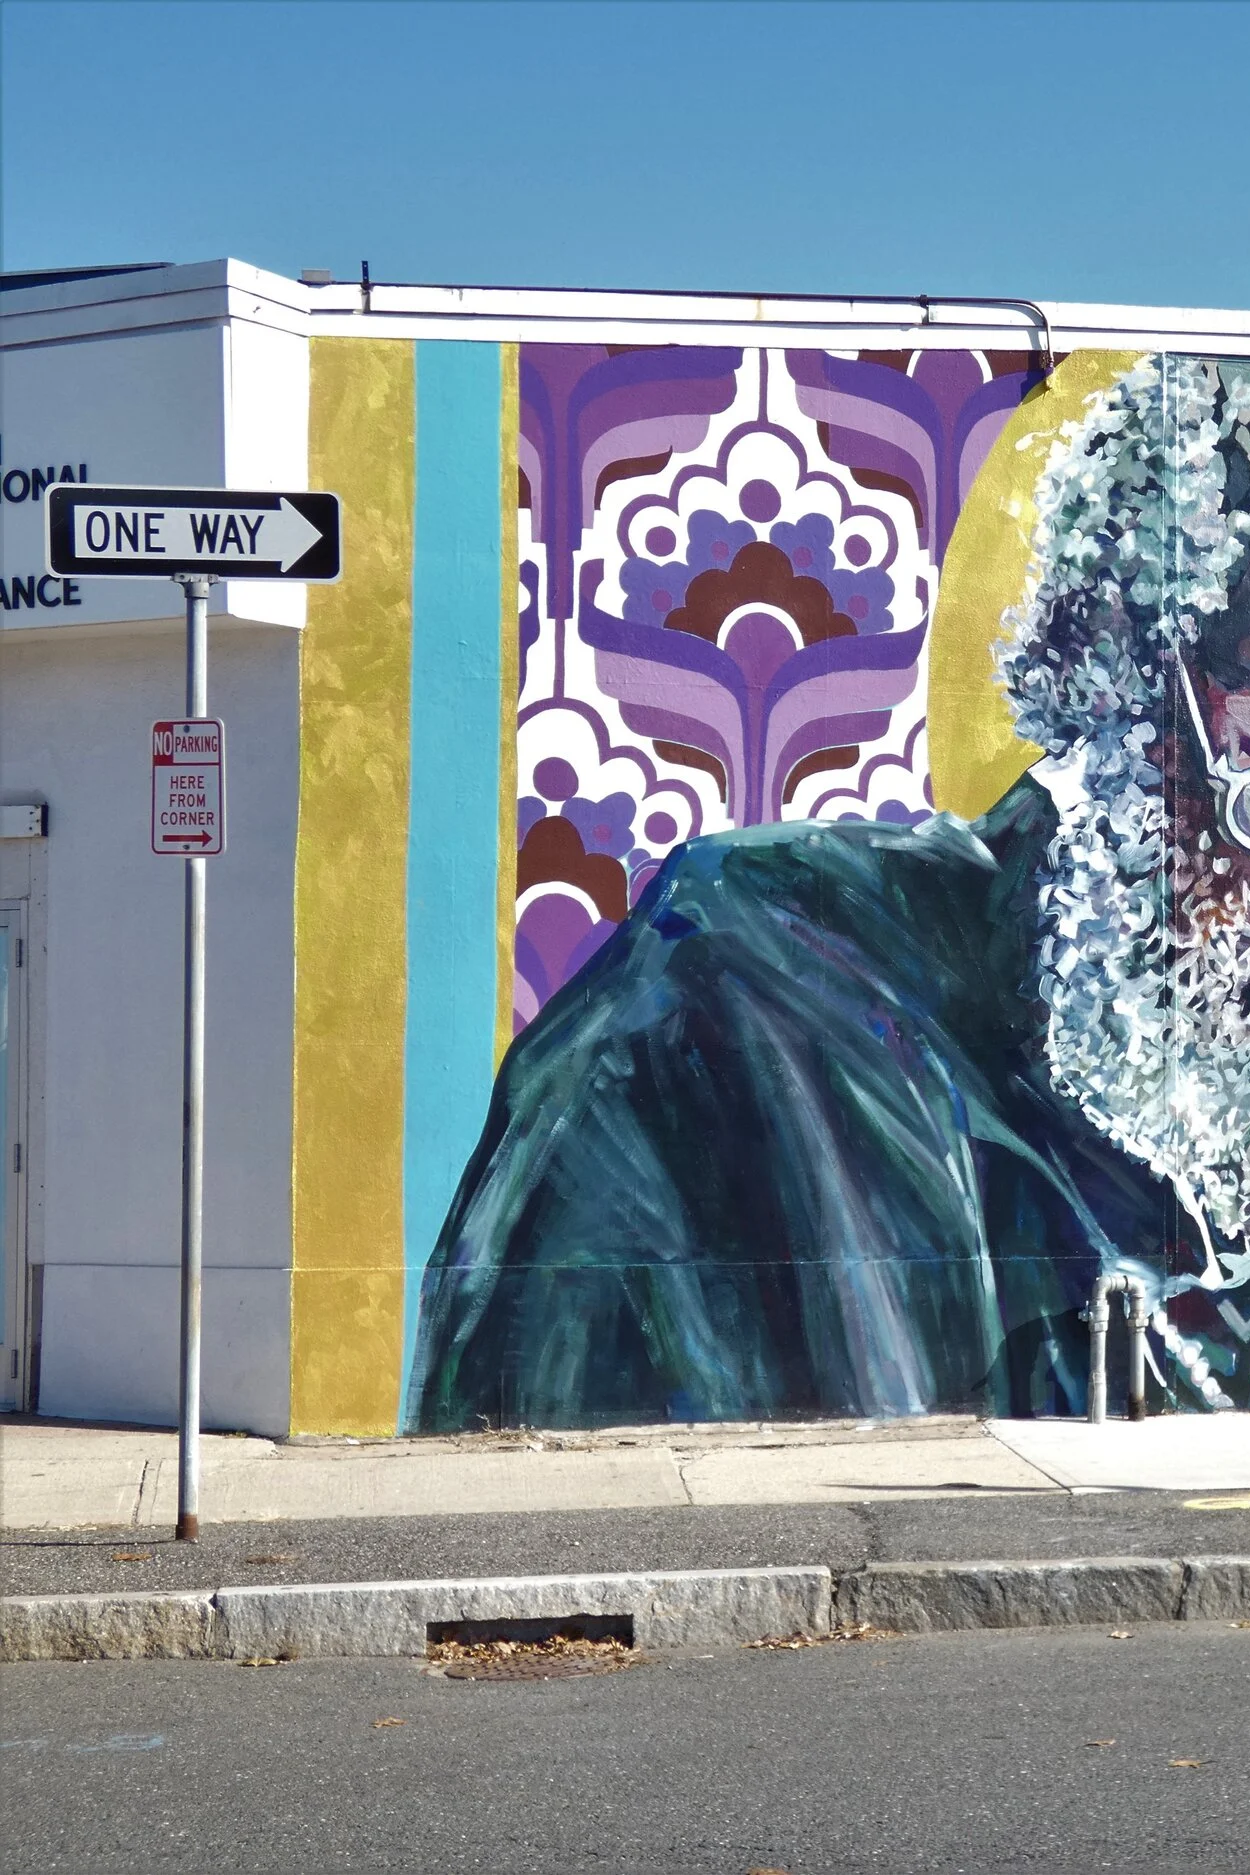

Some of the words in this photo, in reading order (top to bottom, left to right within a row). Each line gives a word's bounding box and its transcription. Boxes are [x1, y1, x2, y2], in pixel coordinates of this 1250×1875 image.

[85, 510, 166, 554] ONE
[190, 512, 265, 555] WAY
[154, 731, 173, 756] NO
[175, 735, 218, 753] PARKING
[170, 775, 205, 790] HERE
[169, 793, 206, 808] FROM
[160, 811, 215, 826] CORNER
